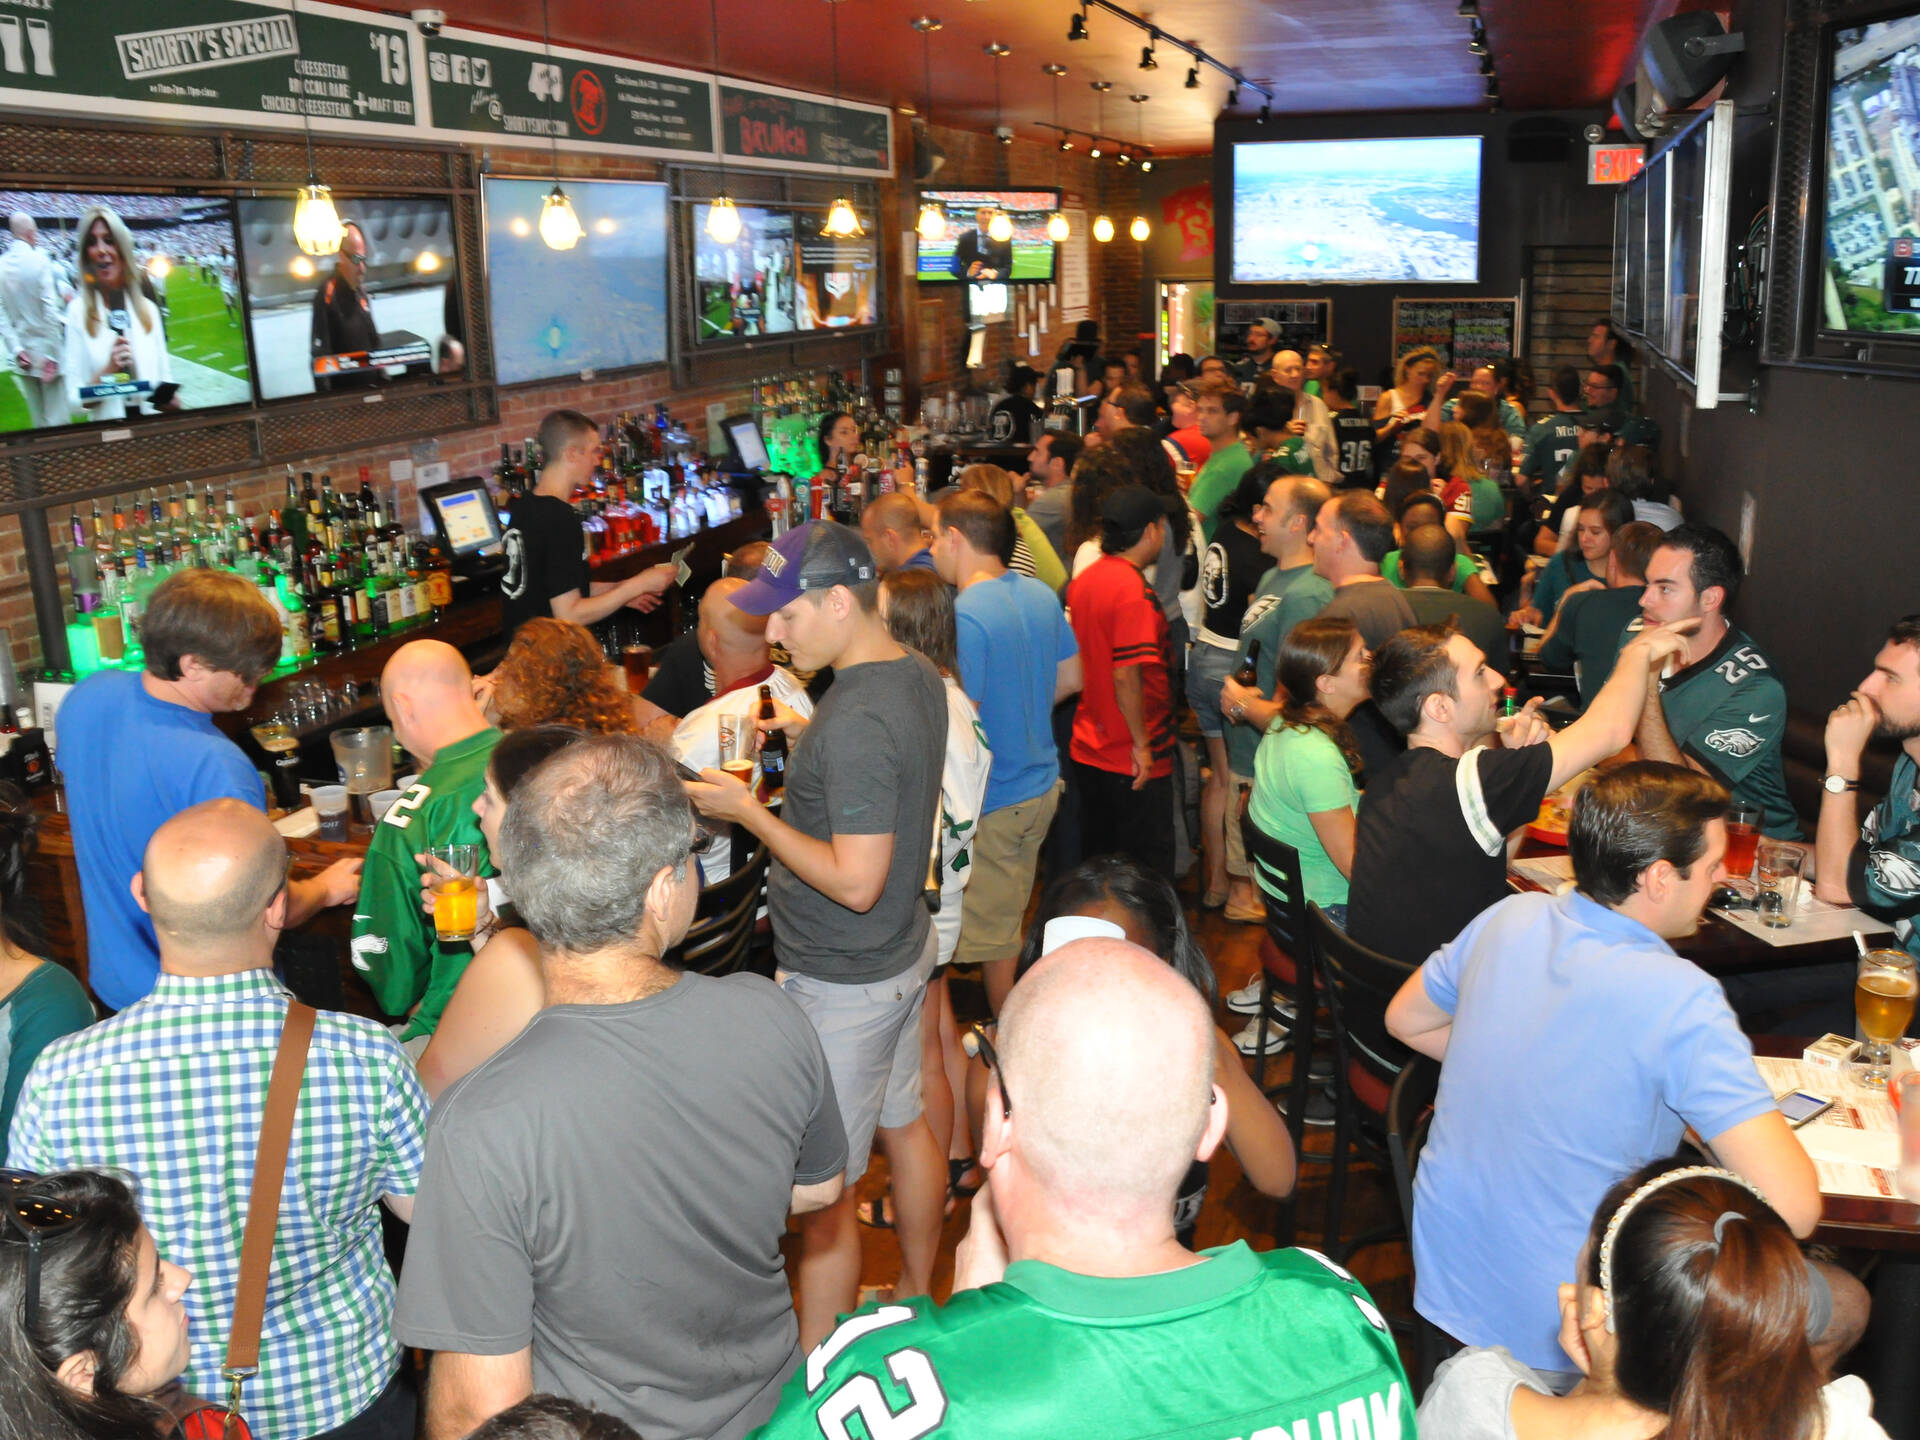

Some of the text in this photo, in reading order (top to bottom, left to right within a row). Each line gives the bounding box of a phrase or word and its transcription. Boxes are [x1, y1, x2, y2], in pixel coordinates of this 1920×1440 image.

[126, 20, 293, 72] SHORTY'S SPECIAL
[369, 31, 409, 86] $13
[739, 115, 809, 156] BRUNCH
[1595, 148, 1644, 183] EXIT
[1340, 440, 1372, 473] 36
[1713, 645, 1769, 685] 25
